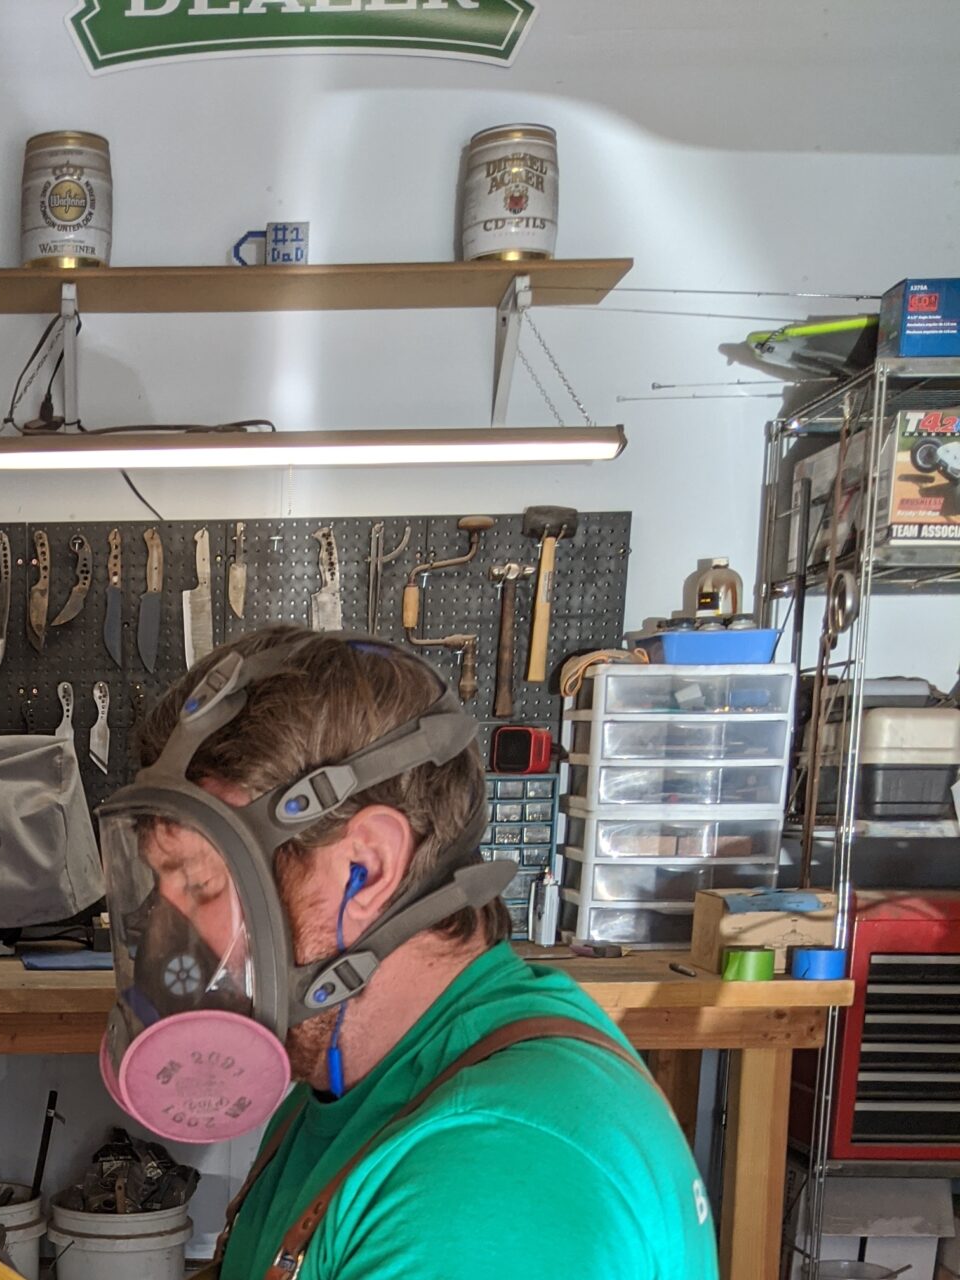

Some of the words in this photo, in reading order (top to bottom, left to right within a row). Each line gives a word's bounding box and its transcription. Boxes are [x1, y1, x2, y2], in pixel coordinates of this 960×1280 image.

[486, 153, 548, 178] DIEL
[272, 224, 304, 245] #1
[39, 243, 96, 256] WARINER
[891, 524, 919, 538] TEAM
